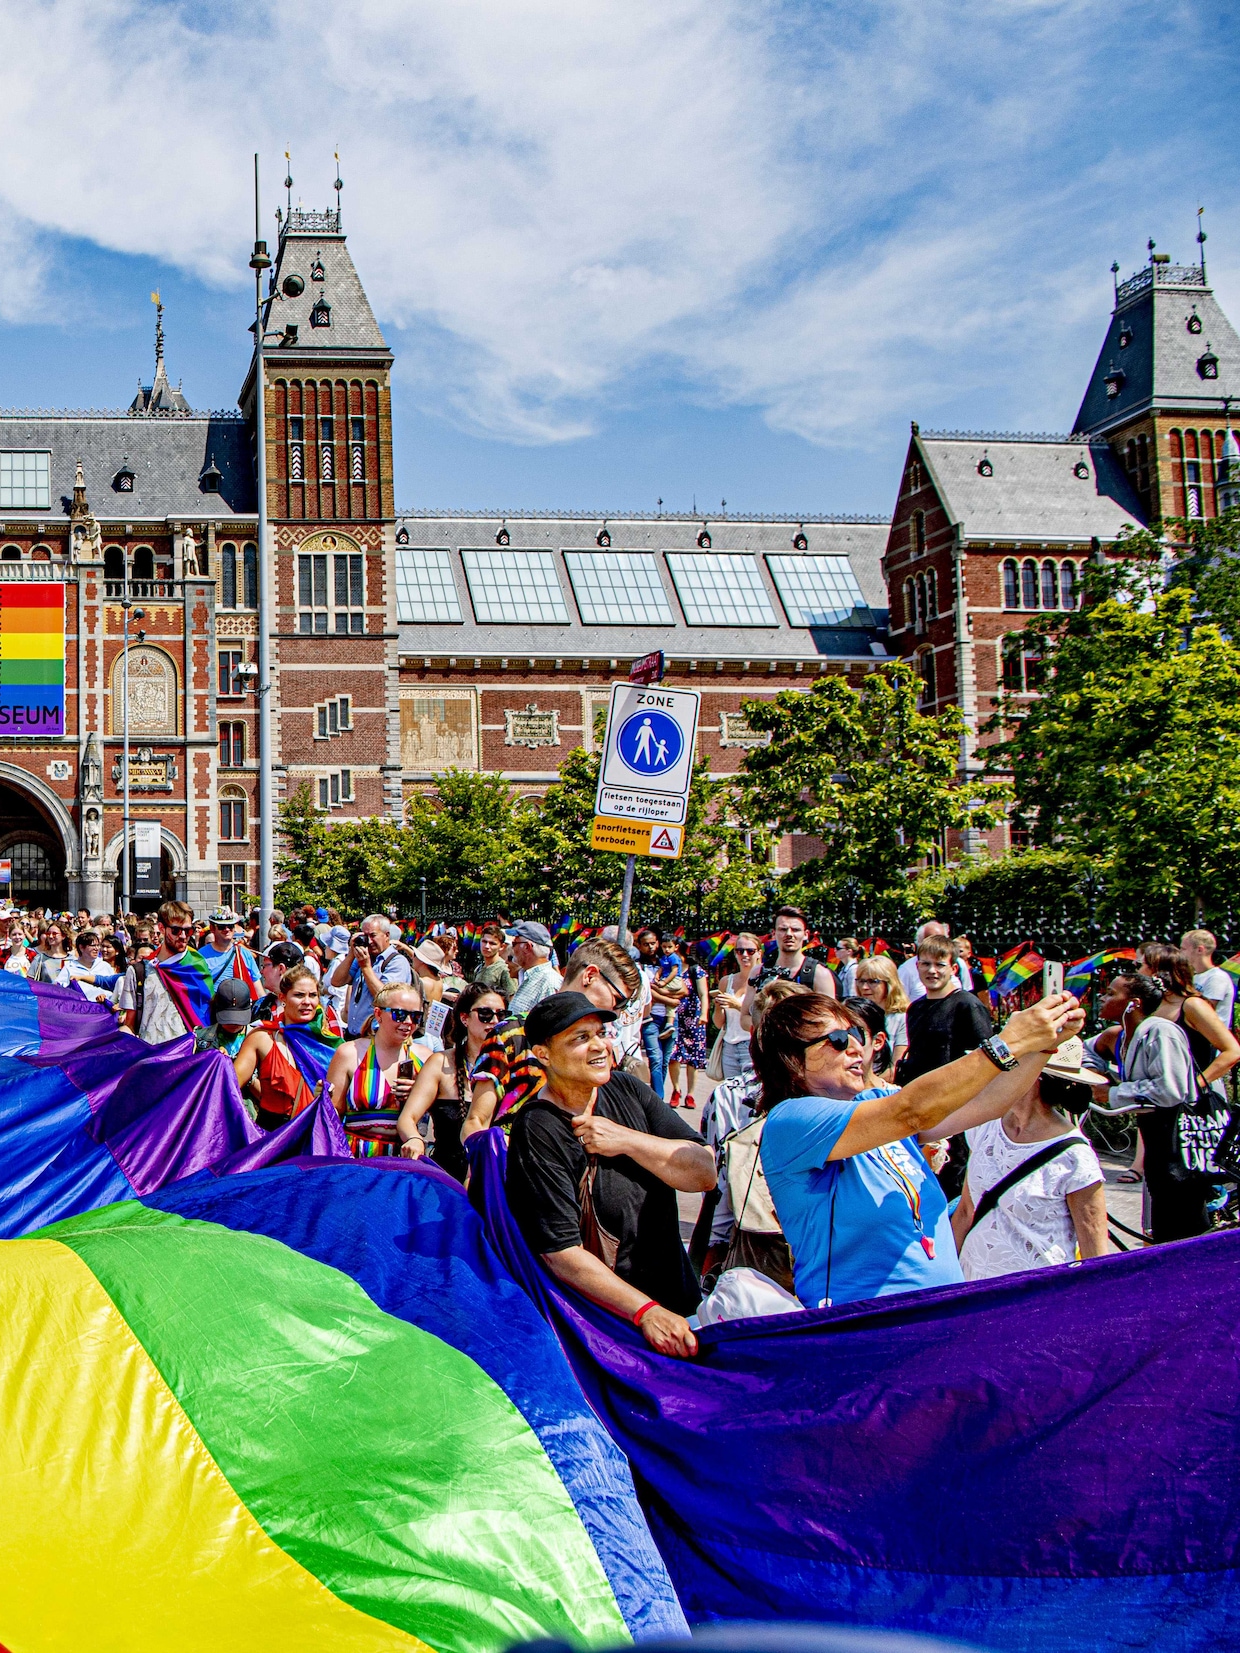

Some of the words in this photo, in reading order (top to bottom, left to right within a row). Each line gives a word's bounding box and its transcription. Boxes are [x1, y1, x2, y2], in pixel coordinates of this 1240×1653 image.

[636, 694, 675, 708] ZONE
[604, 792, 633, 802] fietsen
[635, 796, 681, 808] toegestaan
[613, 804, 624, 812] op
[638, 806, 669, 816] rijloper
[596, 823, 651, 836] snorfietsers
[595, 835, 636, 846] verboden
[428, 1005, 438, 1029] YOUTH
[434, 1008, 446, 1032] PRIDE
[1178, 1109, 1231, 1131] #TEAM
